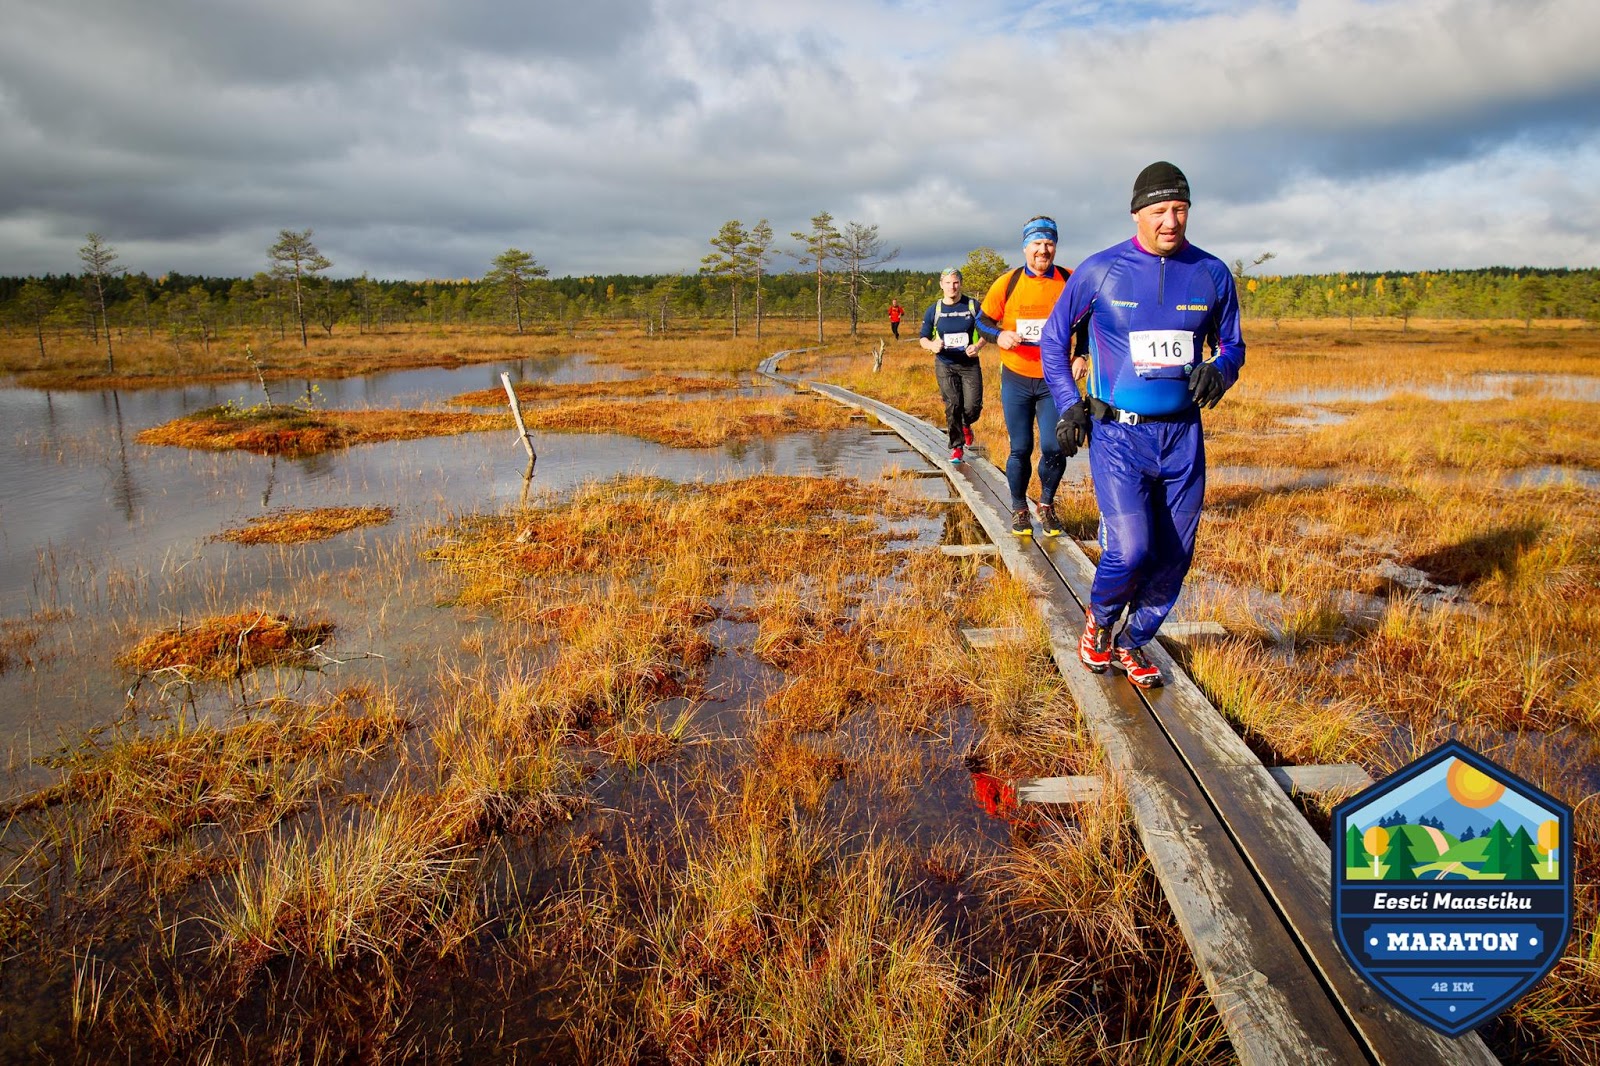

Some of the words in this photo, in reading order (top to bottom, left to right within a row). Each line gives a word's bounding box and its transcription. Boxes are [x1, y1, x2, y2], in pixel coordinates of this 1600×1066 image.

[1025, 325, 1043, 336] 25
[949, 336, 963, 345] 247
[1148, 341, 1182, 358] 116
